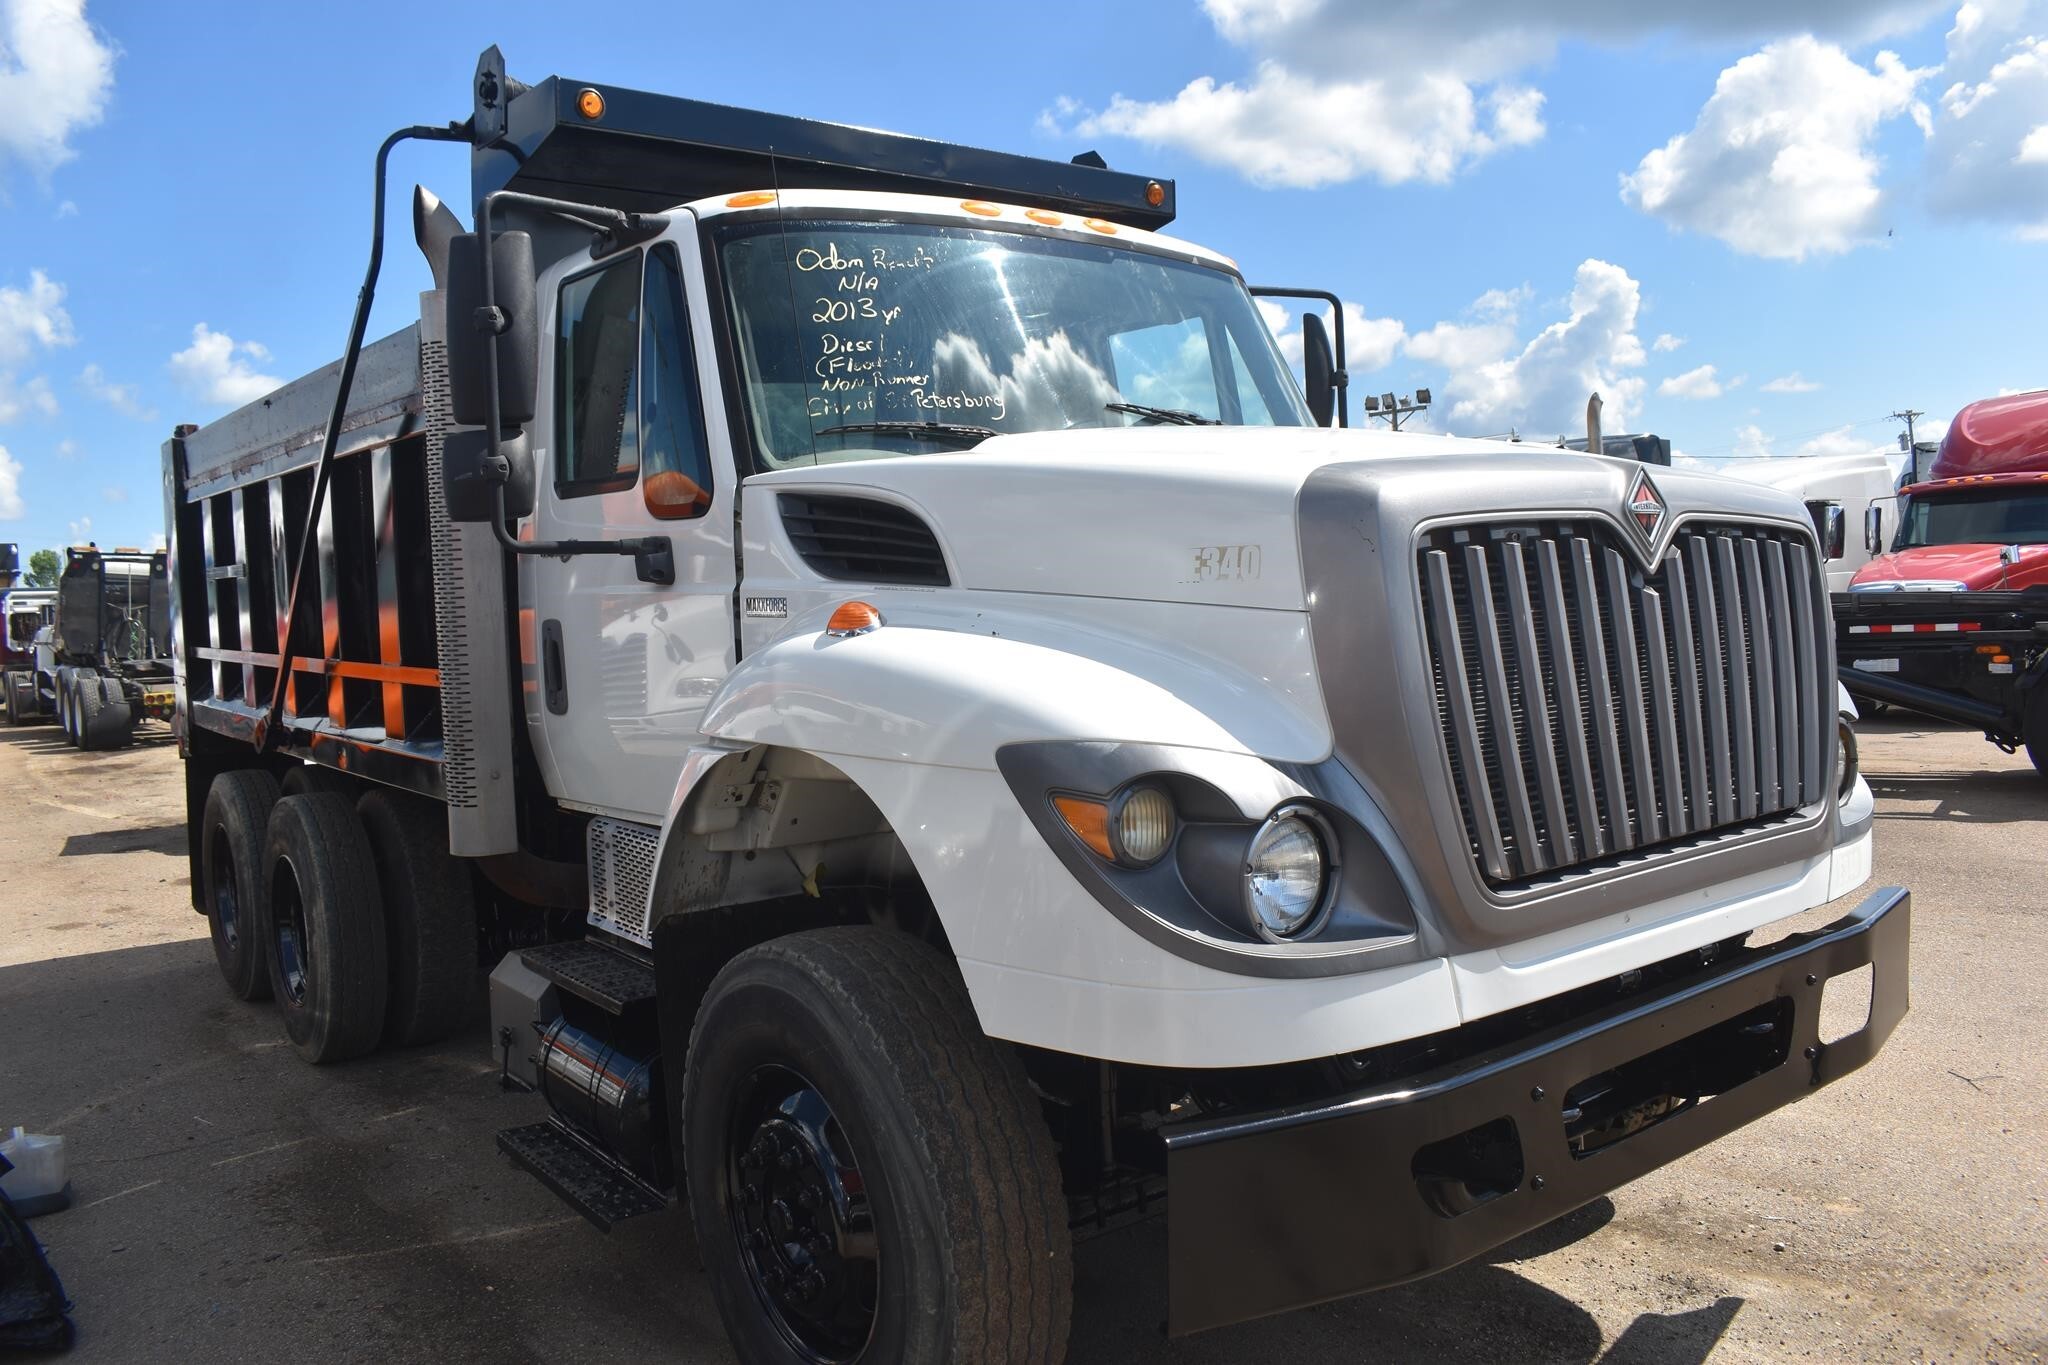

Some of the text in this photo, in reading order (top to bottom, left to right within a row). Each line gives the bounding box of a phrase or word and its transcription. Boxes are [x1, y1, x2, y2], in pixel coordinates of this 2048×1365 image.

[797, 242, 863, 271] Odom
[838, 271, 878, 292] N/A
[812, 298, 877, 323] 2013
[821, 333, 884, 354] Diesel
[873, 371, 930, 388] Runner
[857, 391, 874, 411] of
[910, 388, 1006, 420] Petersburg
[746, 597, 788, 613] MAXXFORCE
